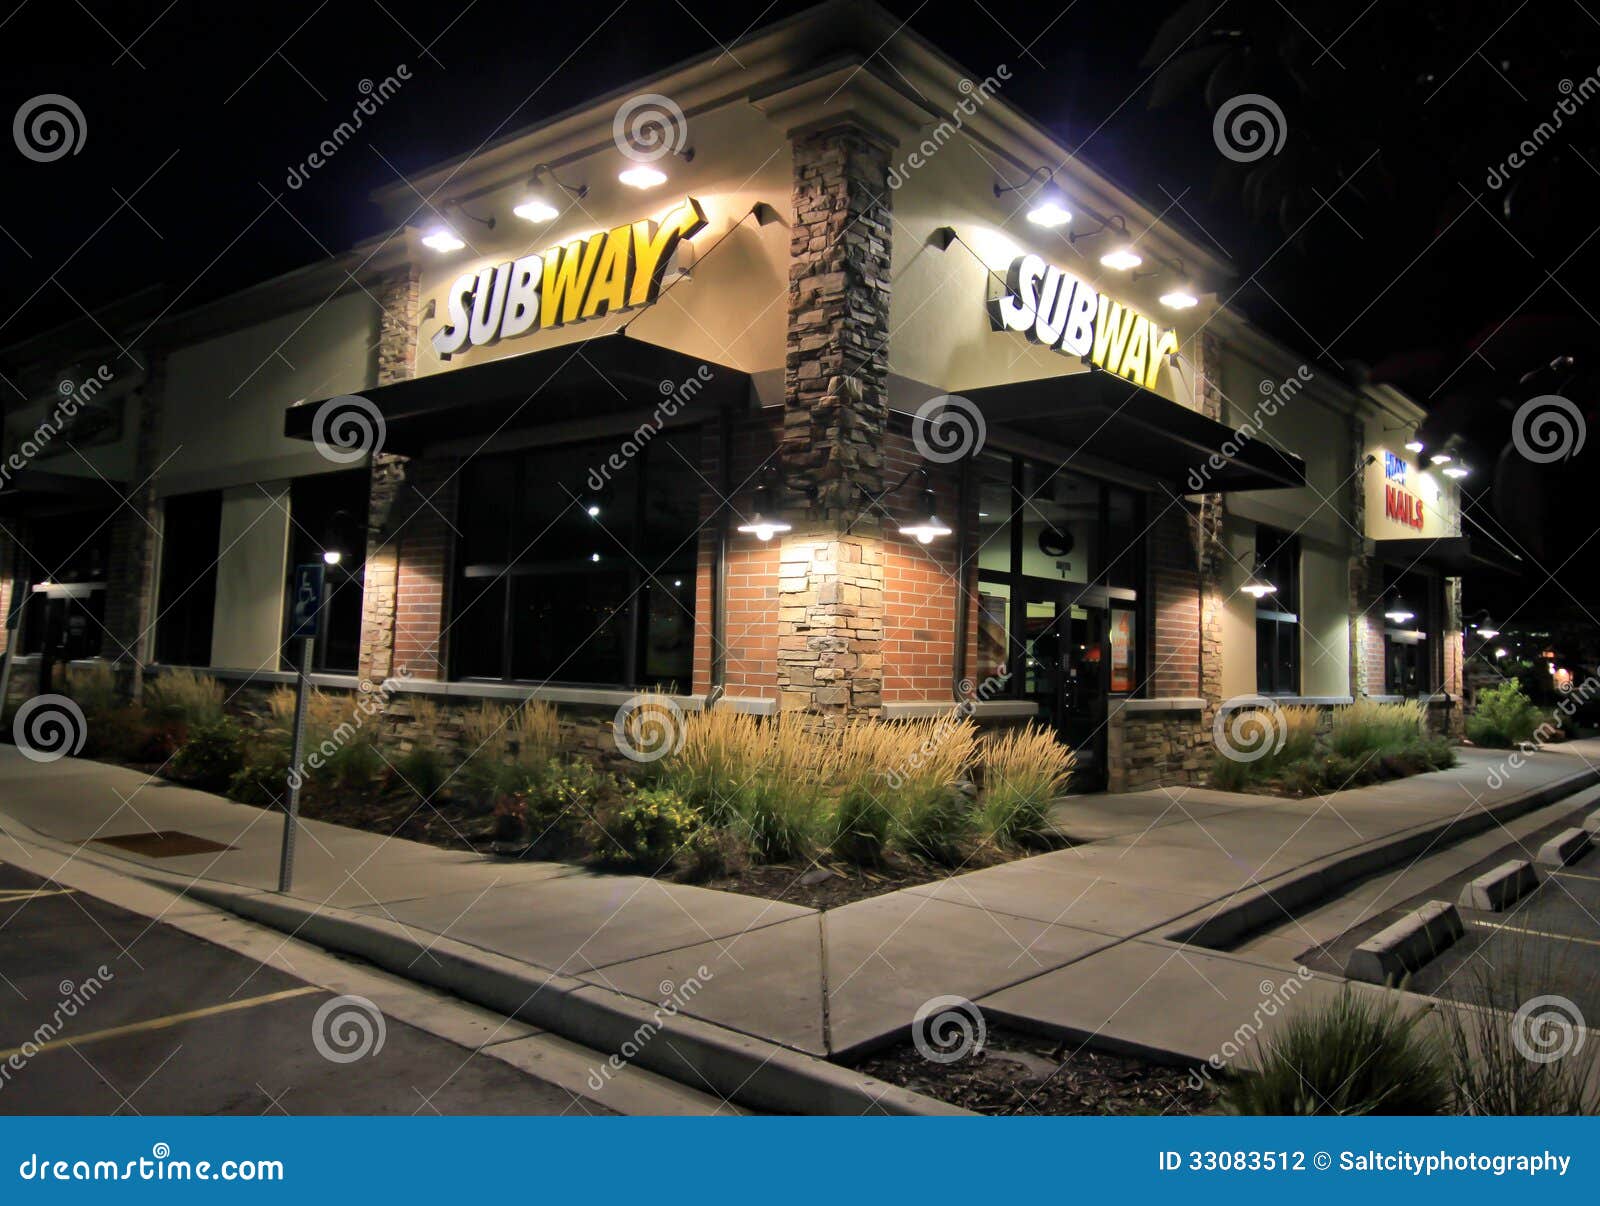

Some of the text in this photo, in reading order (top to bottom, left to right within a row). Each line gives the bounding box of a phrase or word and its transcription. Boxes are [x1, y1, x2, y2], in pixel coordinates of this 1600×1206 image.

[431, 195, 708, 361] SUBWAY
[988, 254, 1180, 390] SUBWAY
[1385, 483, 1424, 530] NAILS
